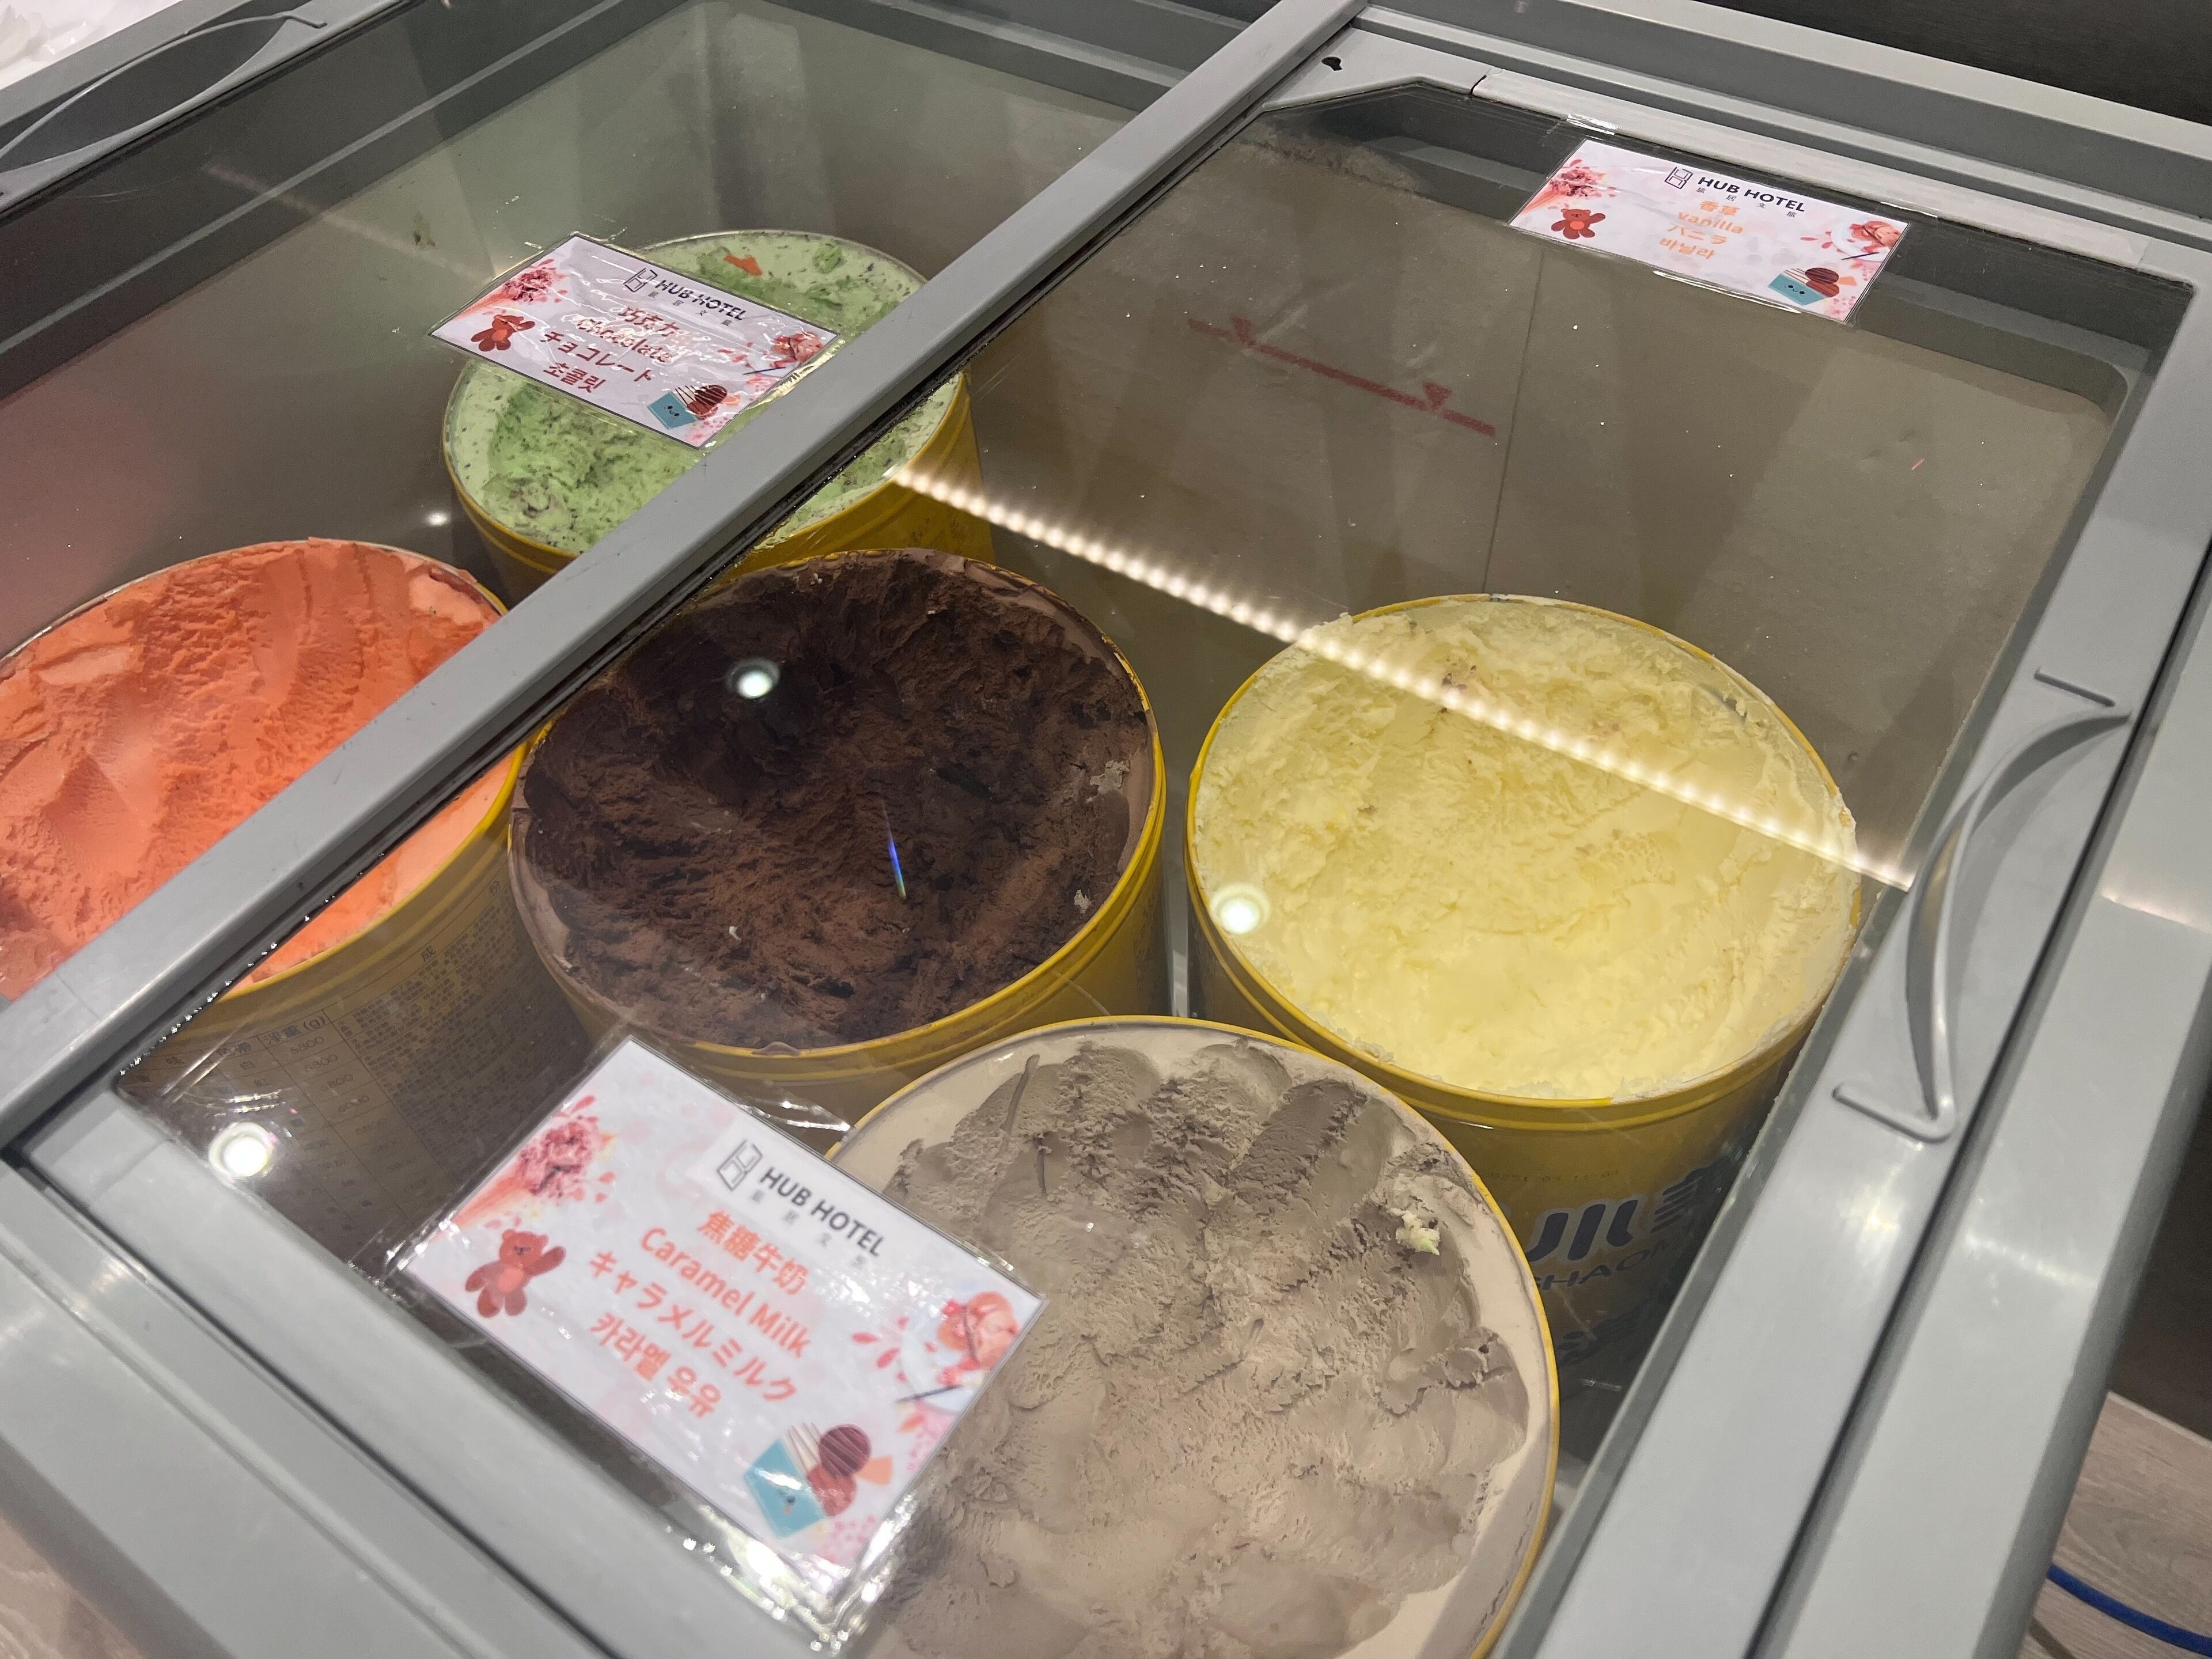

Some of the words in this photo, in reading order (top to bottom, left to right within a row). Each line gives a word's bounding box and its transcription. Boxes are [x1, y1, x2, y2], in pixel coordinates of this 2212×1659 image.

[1698, 176, 1740, 194] HUB
[1744, 188, 1806, 213] HOTEL
[654, 279, 694, 300] HUB
[691, 294, 746, 321] HOTEL
[540, 331, 652, 382] チョコレート
[543, 362, 606, 393] 초콜릿
[759, 1166, 813, 1207] HUB
[810, 1199, 885, 1257] HOTEL
[696, 1210, 809, 1296] 焦糖牛奶
[640, 1228, 755, 1317] Caramel
[748, 1303, 811, 1359] Milk
[589, 1251, 797, 1402] キャラメルミルク
[667, 1366, 722, 1419] 우유
